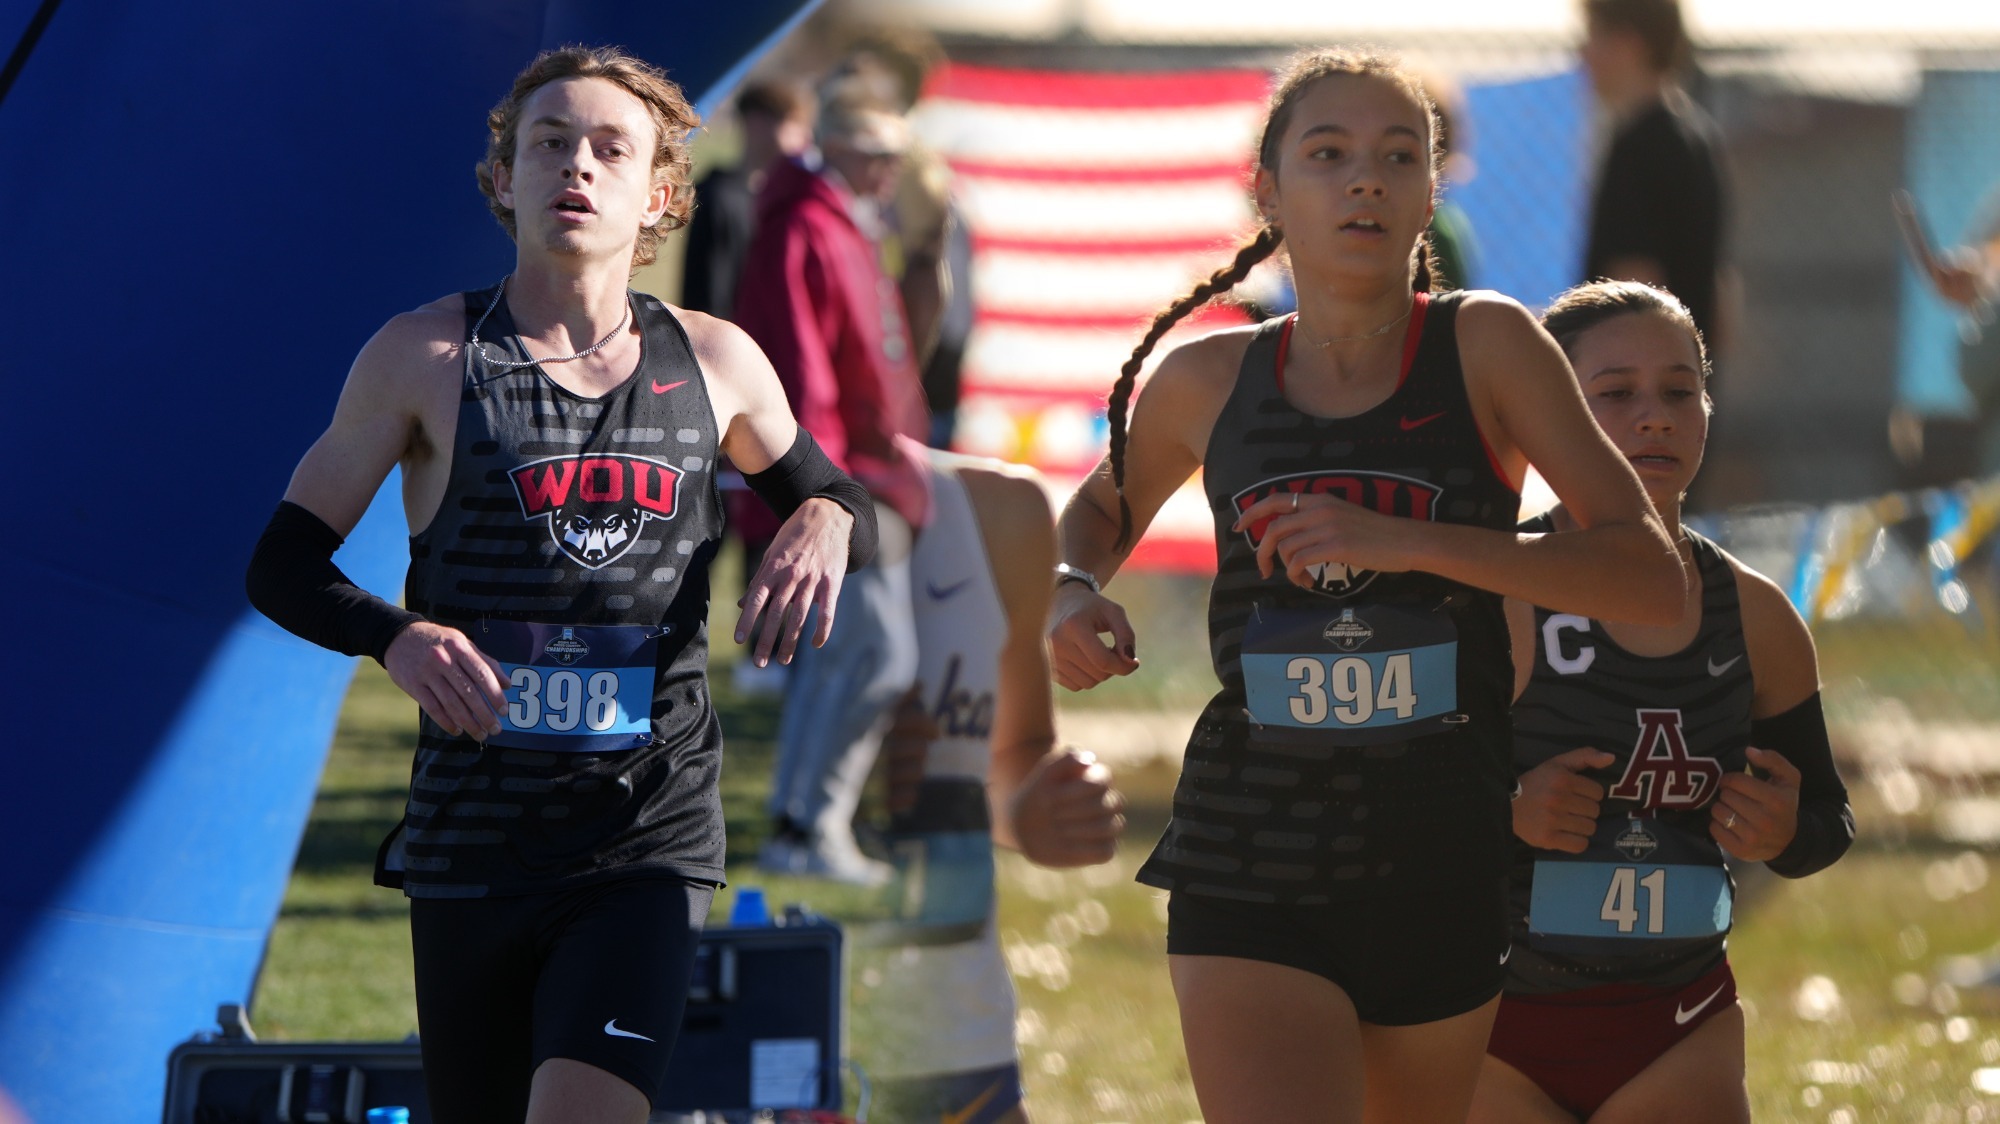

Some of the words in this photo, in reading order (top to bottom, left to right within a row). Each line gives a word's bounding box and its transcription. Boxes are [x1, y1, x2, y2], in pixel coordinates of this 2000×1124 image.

[515, 458, 681, 514] WOU
[1541, 613, 1596, 675] C
[507, 667, 620, 732] 398
[1286, 652, 1417, 725] 394
[1600, 866, 1668, 934] 41
